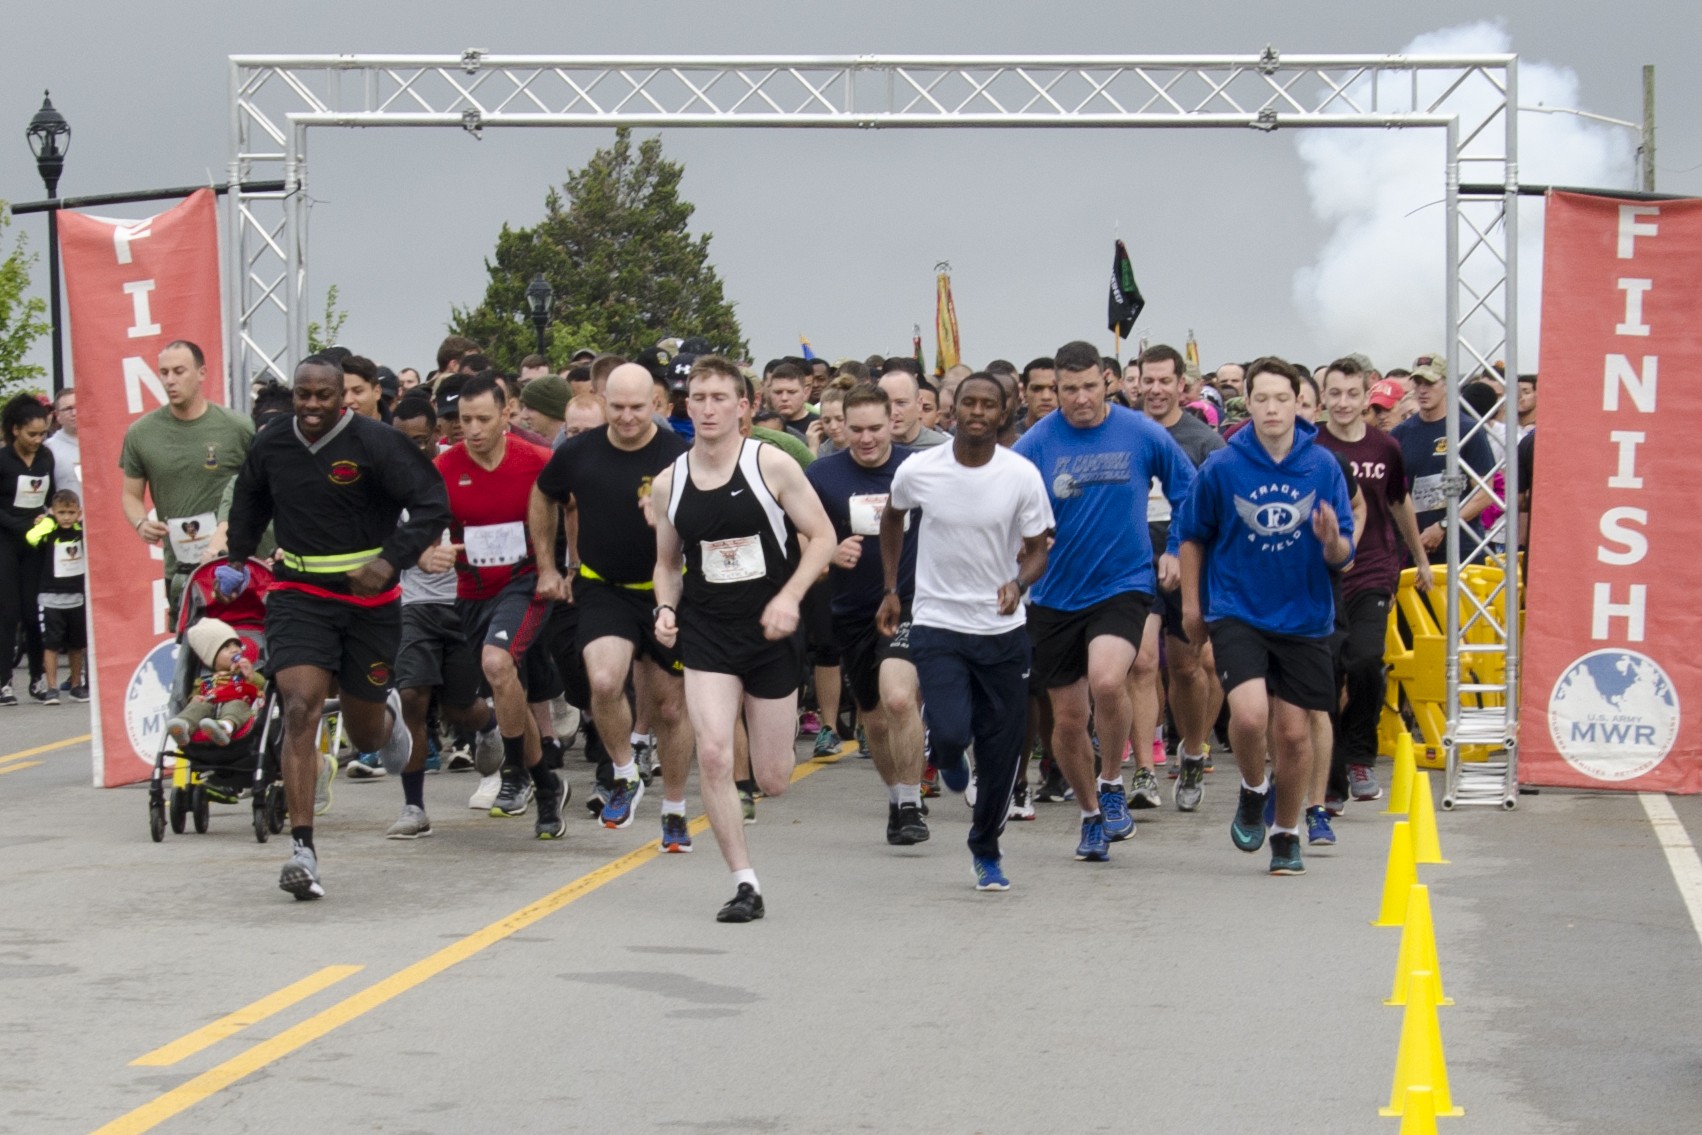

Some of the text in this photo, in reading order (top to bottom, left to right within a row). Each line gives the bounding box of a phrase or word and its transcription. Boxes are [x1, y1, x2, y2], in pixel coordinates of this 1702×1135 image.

[1591, 204, 1660, 642] FINISH
[1249, 483, 1300, 500] TRACK
[1261, 530, 1302, 552] FIELD
[1587, 713, 1643, 723] U.S. ARMY
[1570, 721, 1656, 746] MWR
